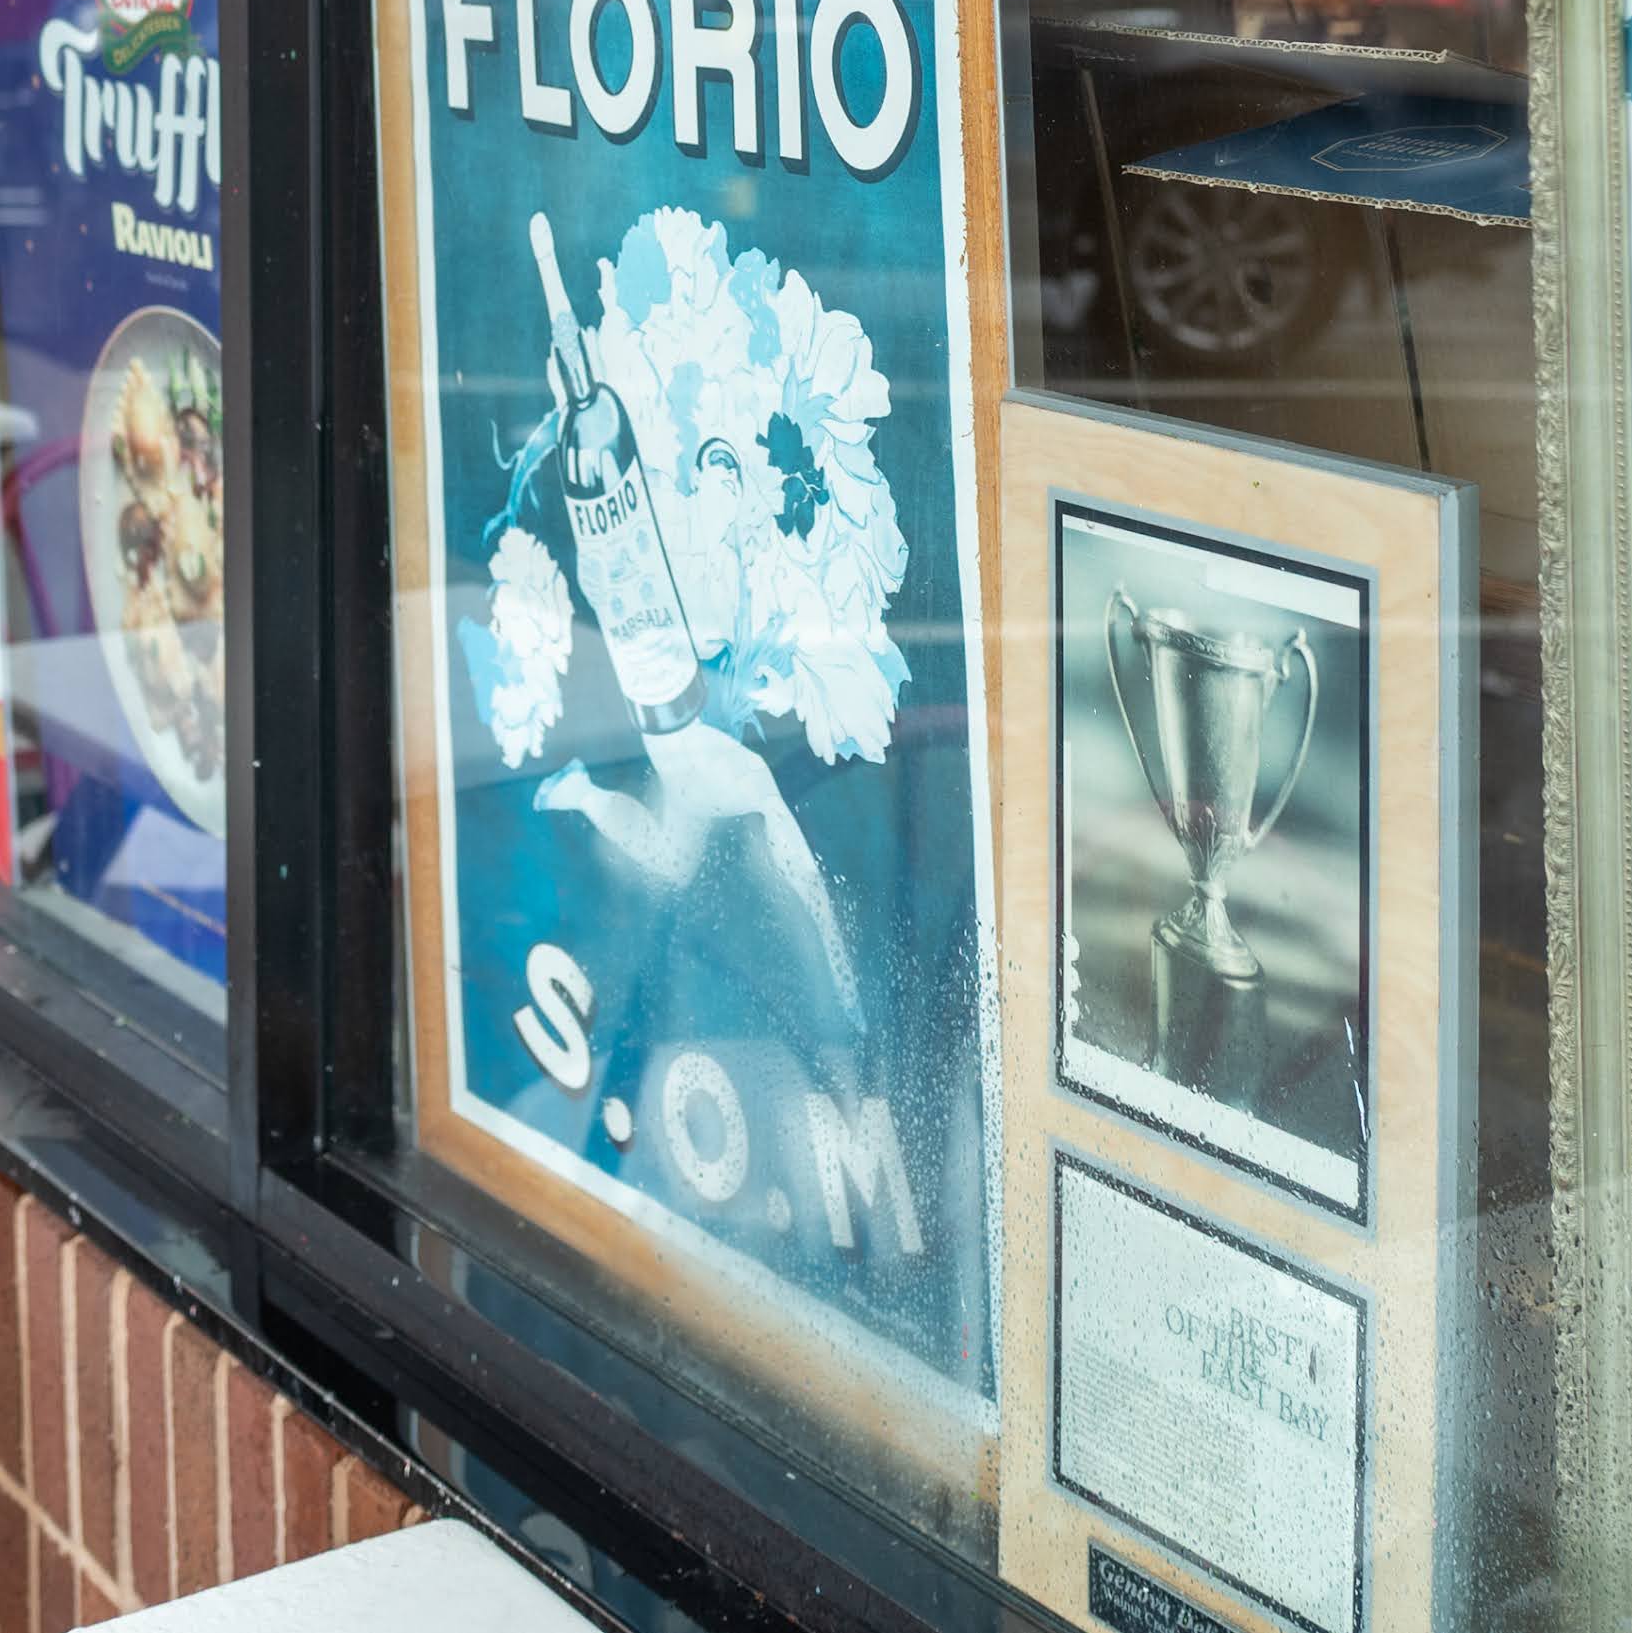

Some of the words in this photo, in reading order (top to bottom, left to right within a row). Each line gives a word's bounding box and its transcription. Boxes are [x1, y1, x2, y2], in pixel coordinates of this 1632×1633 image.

[111, 201, 214, 272] RAVIOLI
[574, 479, 637, 536] FLORIO
[610, 607, 675, 643] MARSALA
[1165, 1303, 1199, 1344] OF
[1230, 1306, 1299, 1366] BEST
[1201, 1349, 1271, 1410] EAST
[1278, 1390, 1330, 1442] BAY
[1098, 1559, 1172, 1623] Genova
